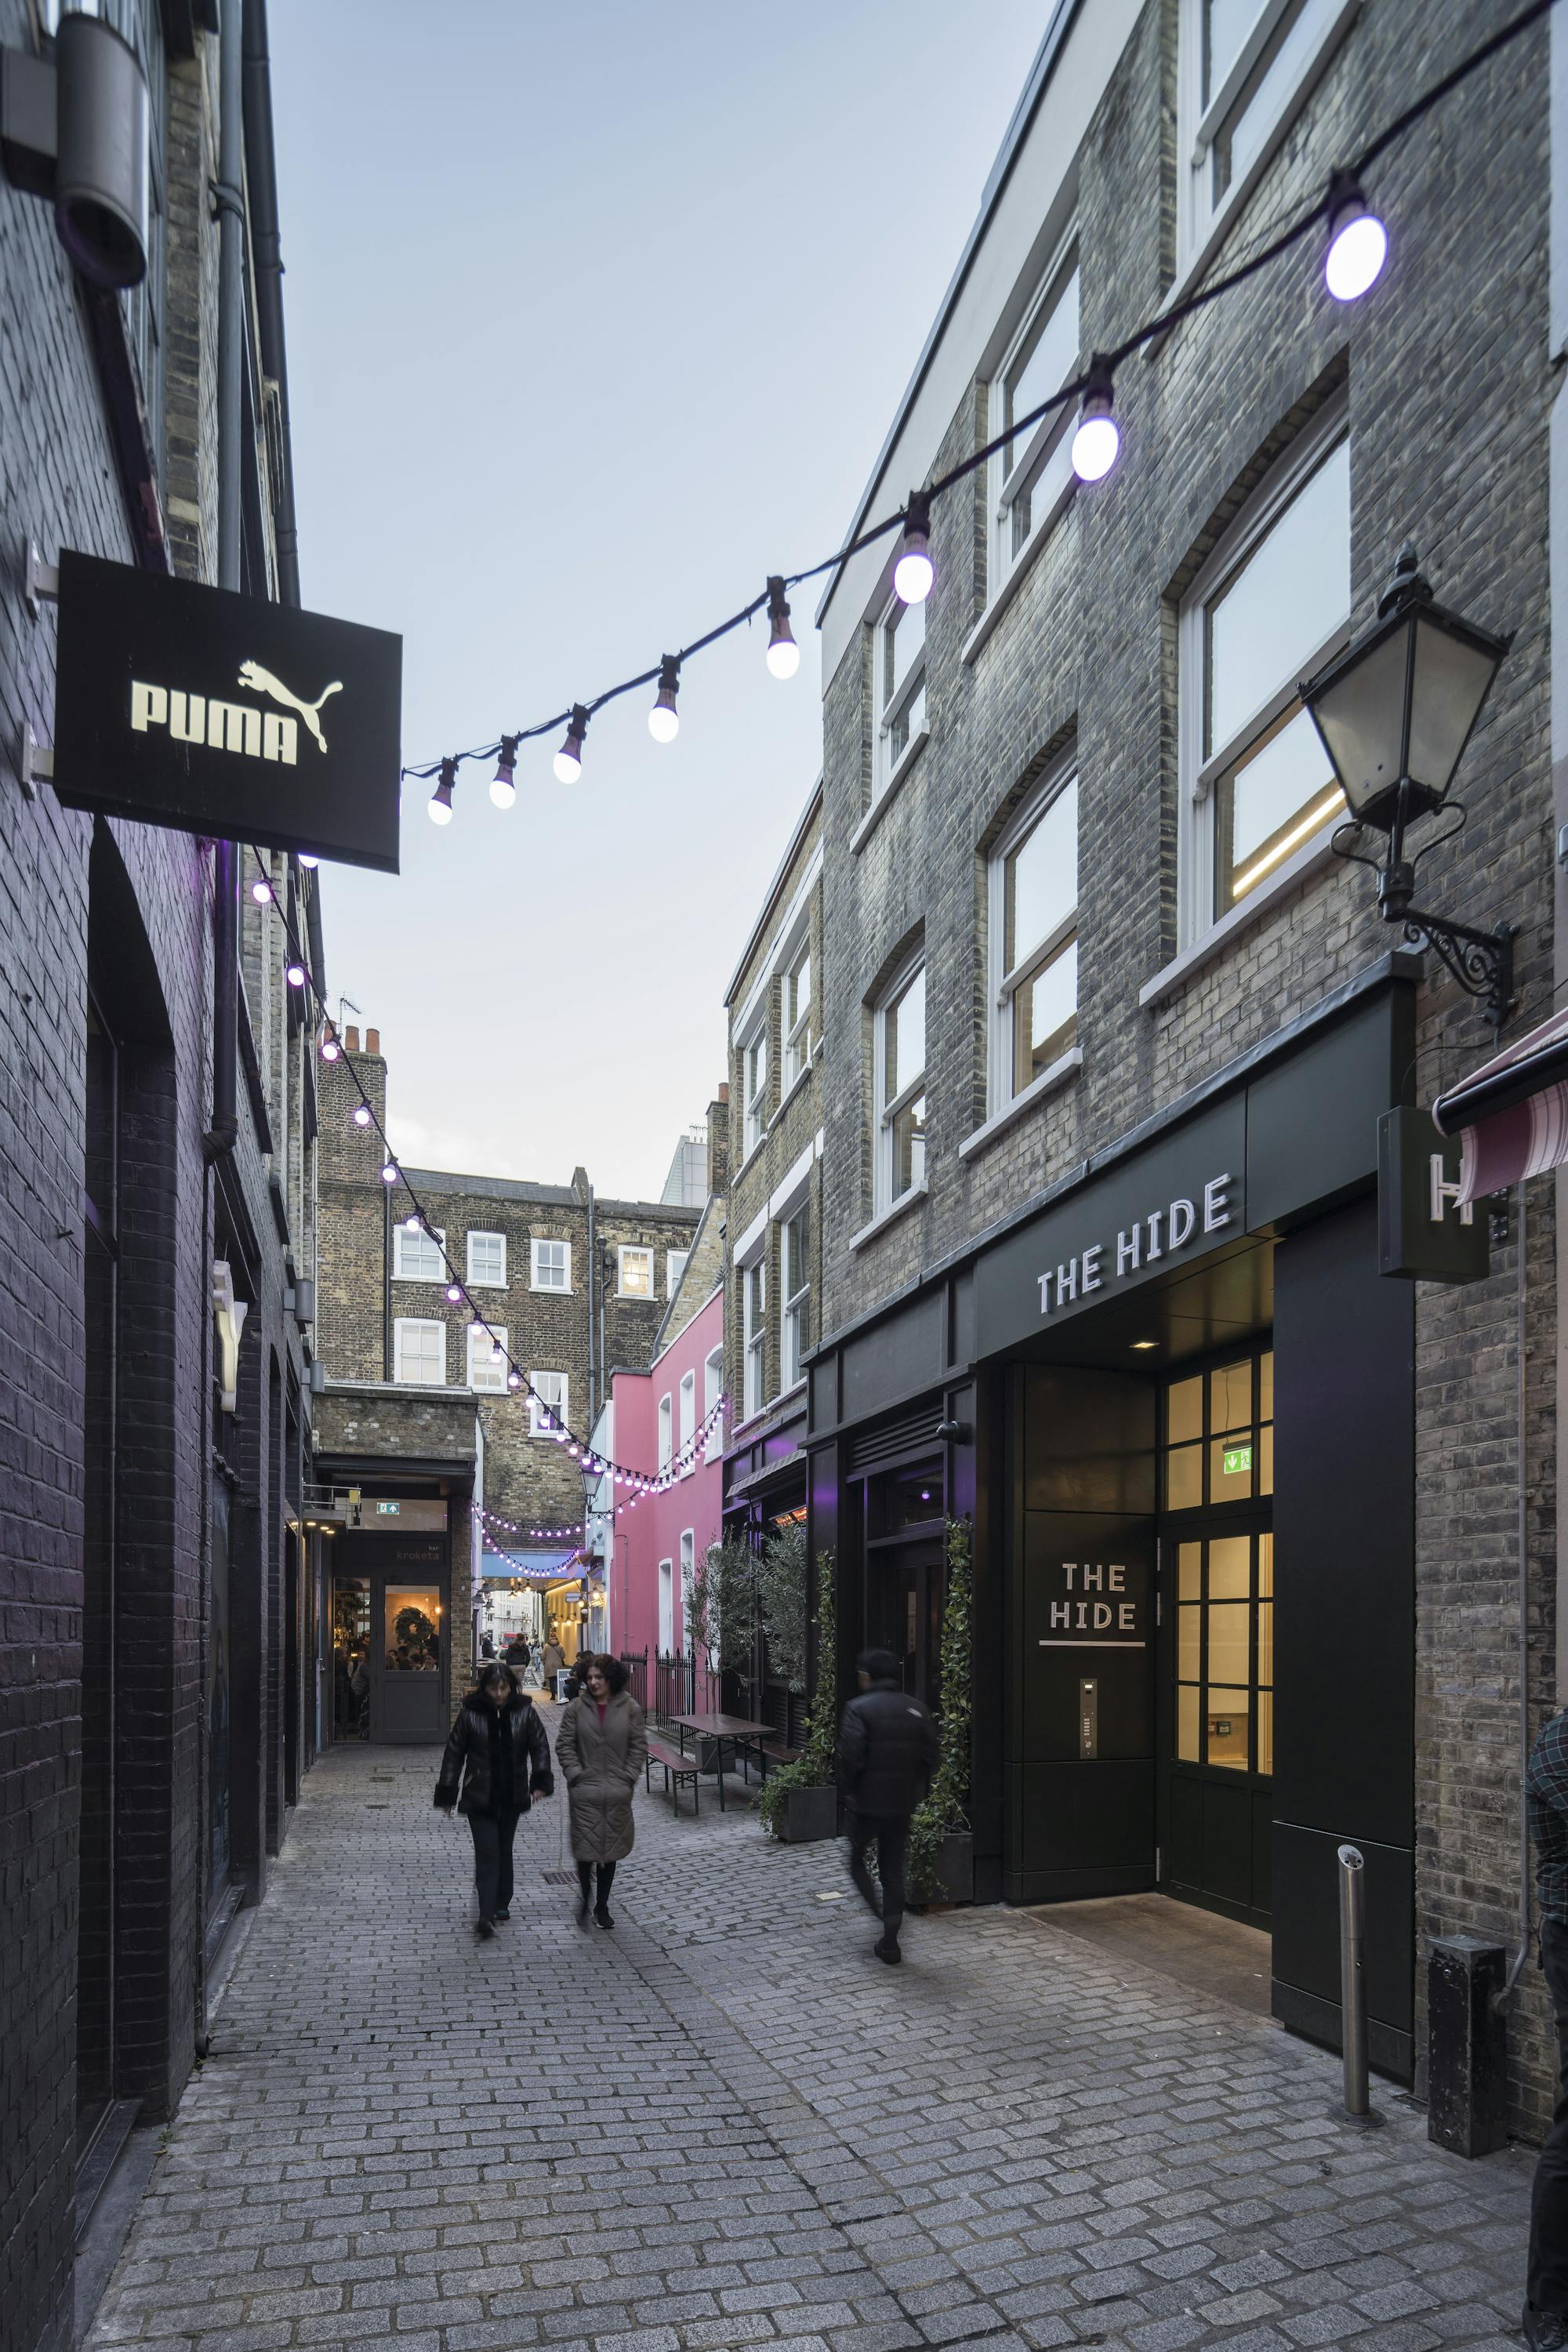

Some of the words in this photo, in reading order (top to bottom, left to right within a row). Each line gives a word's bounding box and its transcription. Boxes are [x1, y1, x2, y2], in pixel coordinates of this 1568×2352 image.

[131, 680, 298, 765] PUMA
[1430, 1153, 1474, 1225] H
[1037, 1244, 1102, 1314] THE
[1116, 1173, 1232, 1277] HIDE
[396, 1550, 440, 1561] kroketa
[1062, 1563, 1126, 1592] THE
[1051, 1602, 1136, 1630] HIDE
